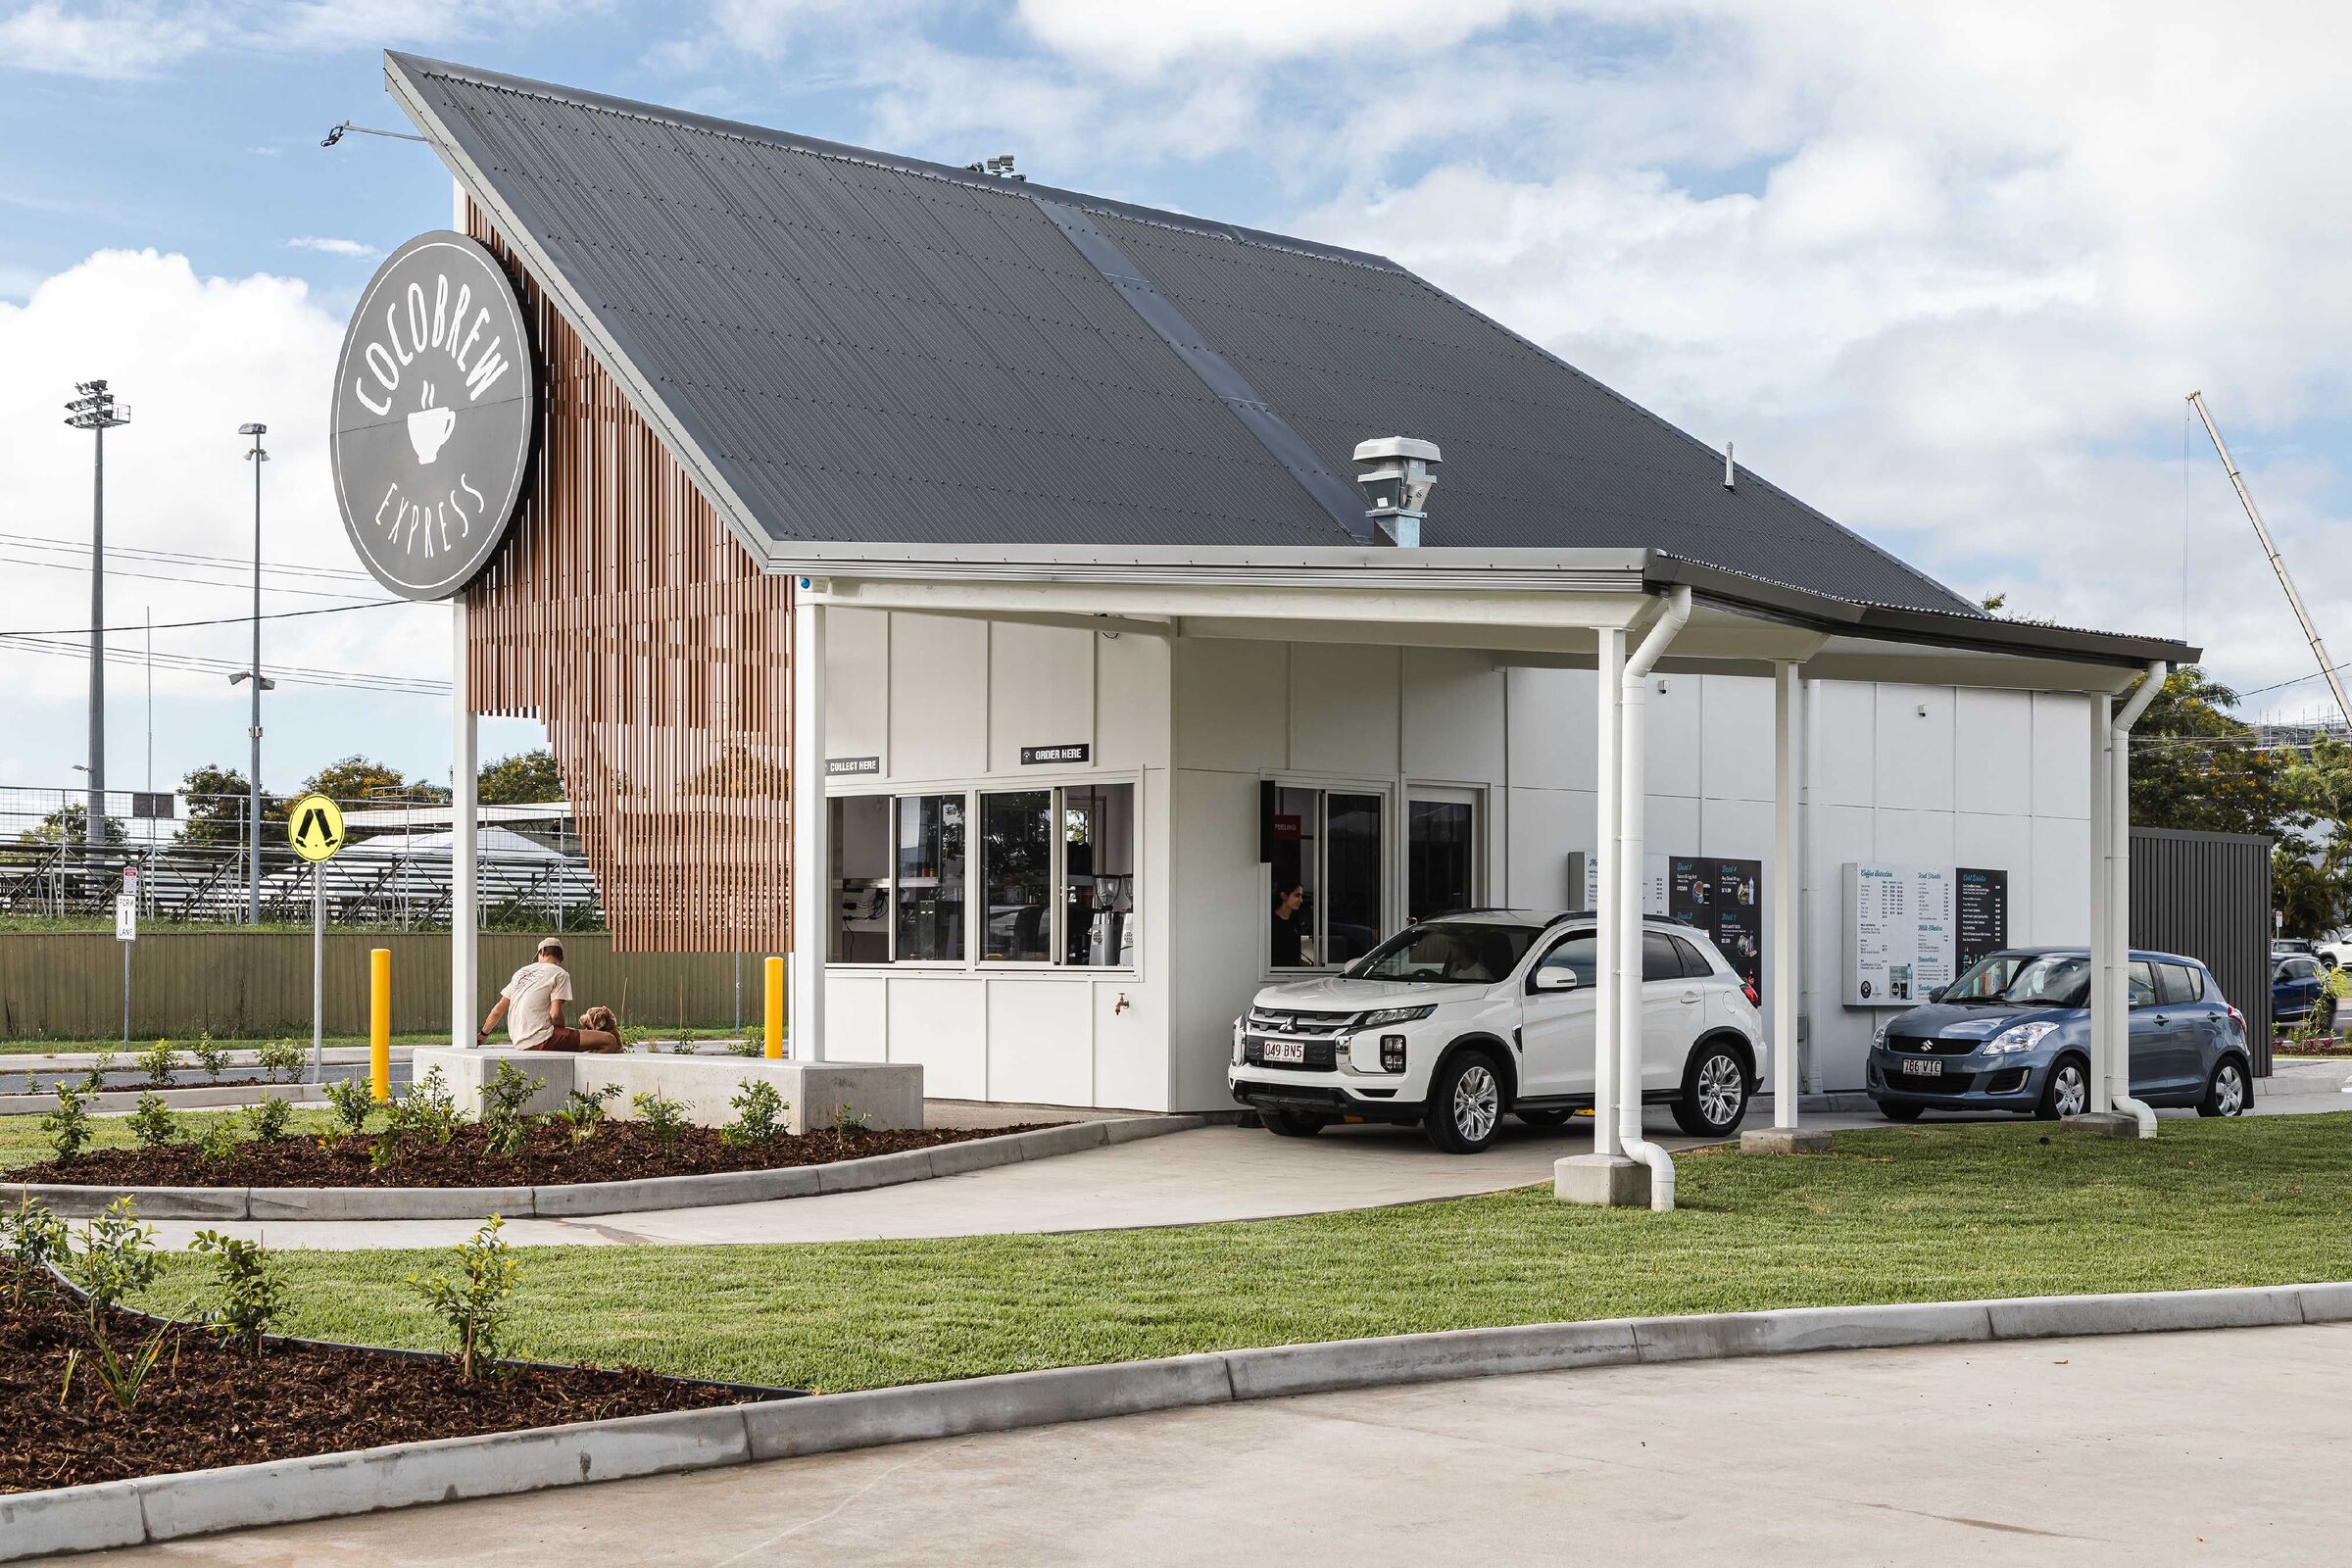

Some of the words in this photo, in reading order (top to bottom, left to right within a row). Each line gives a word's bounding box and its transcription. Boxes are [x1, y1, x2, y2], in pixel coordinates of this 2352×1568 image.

[356, 274, 509, 416] COCOBREW
[375, 472, 485, 559] EXPRESS
[1035, 749, 1060, 760] ORDER
[1061, 748, 1082, 760] HERE
[830, 761, 858, 772] COLLECT
[858, 760, 876, 771] HERE
[1860, 868, 1874, 879] Coffee
[119, 898, 134, 907] FORM
[124, 910, 128, 925] 1
[119, 928, 133, 937] LANE
